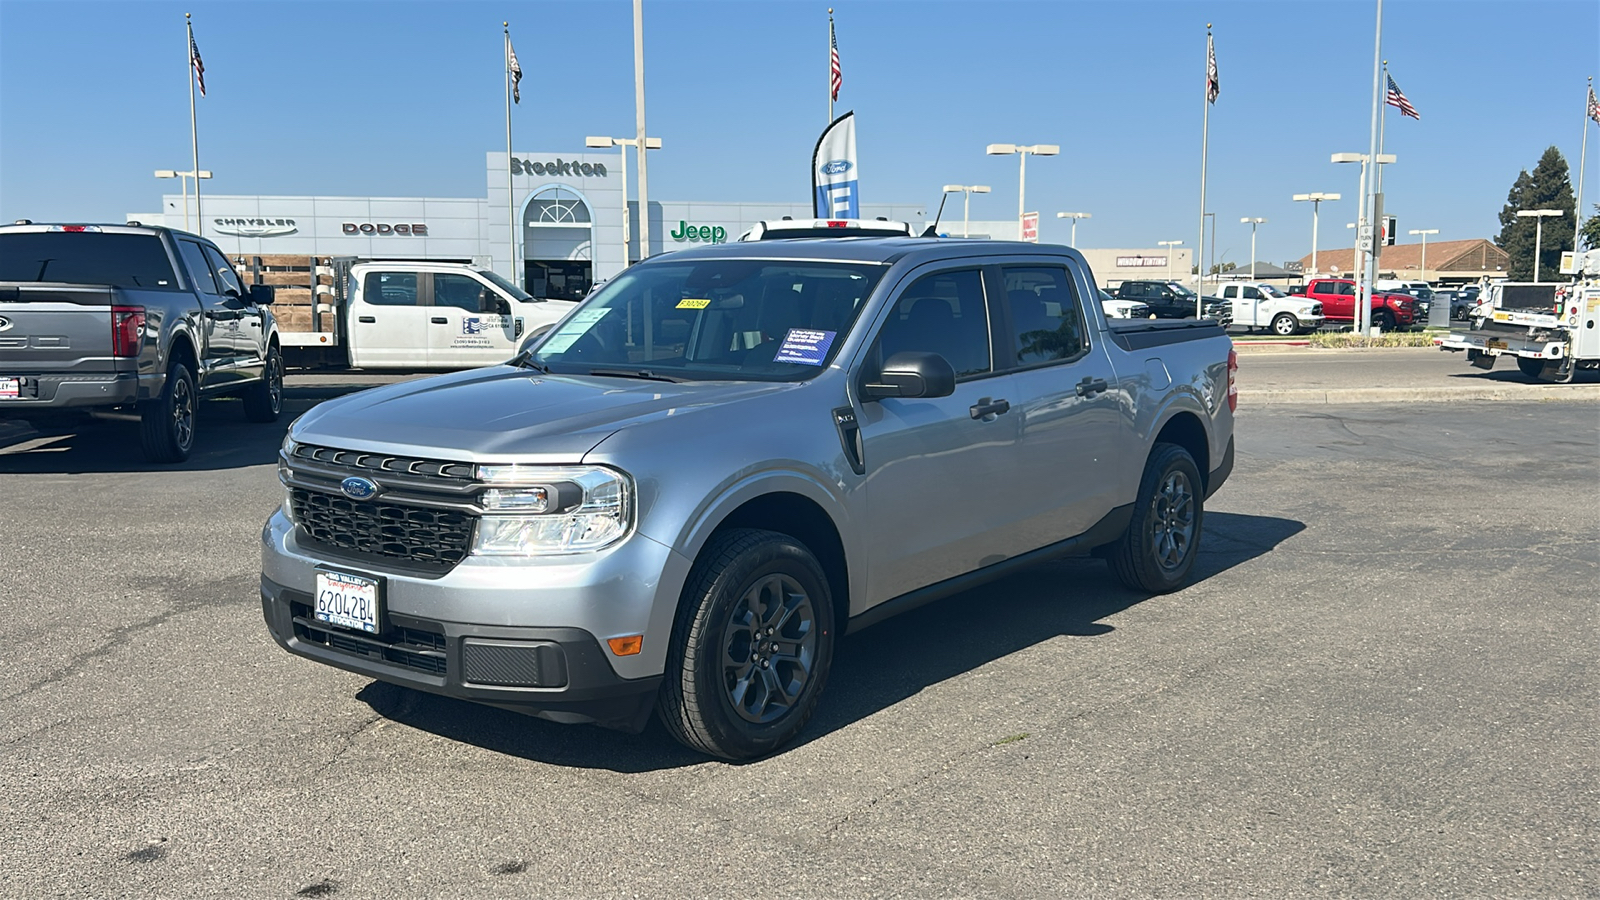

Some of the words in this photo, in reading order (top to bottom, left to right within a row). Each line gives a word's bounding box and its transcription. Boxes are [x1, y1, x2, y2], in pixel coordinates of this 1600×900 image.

[510, 157, 607, 177] Stockton
[826, 161, 847, 174] Ford
[214, 218, 296, 227] CHRYSLER
[342, 223, 428, 236] DODGE
[670, 220, 726, 243] Jeep
[1117, 257, 1142, 266] WINDOW
[1143, 257, 1167, 266] TINTING
[346, 481, 367, 496] Ford
[340, 574, 363, 586] VALLEY
[318, 589, 374, 623] 62042B4
[329, 614, 364, 630] STOCKTON
